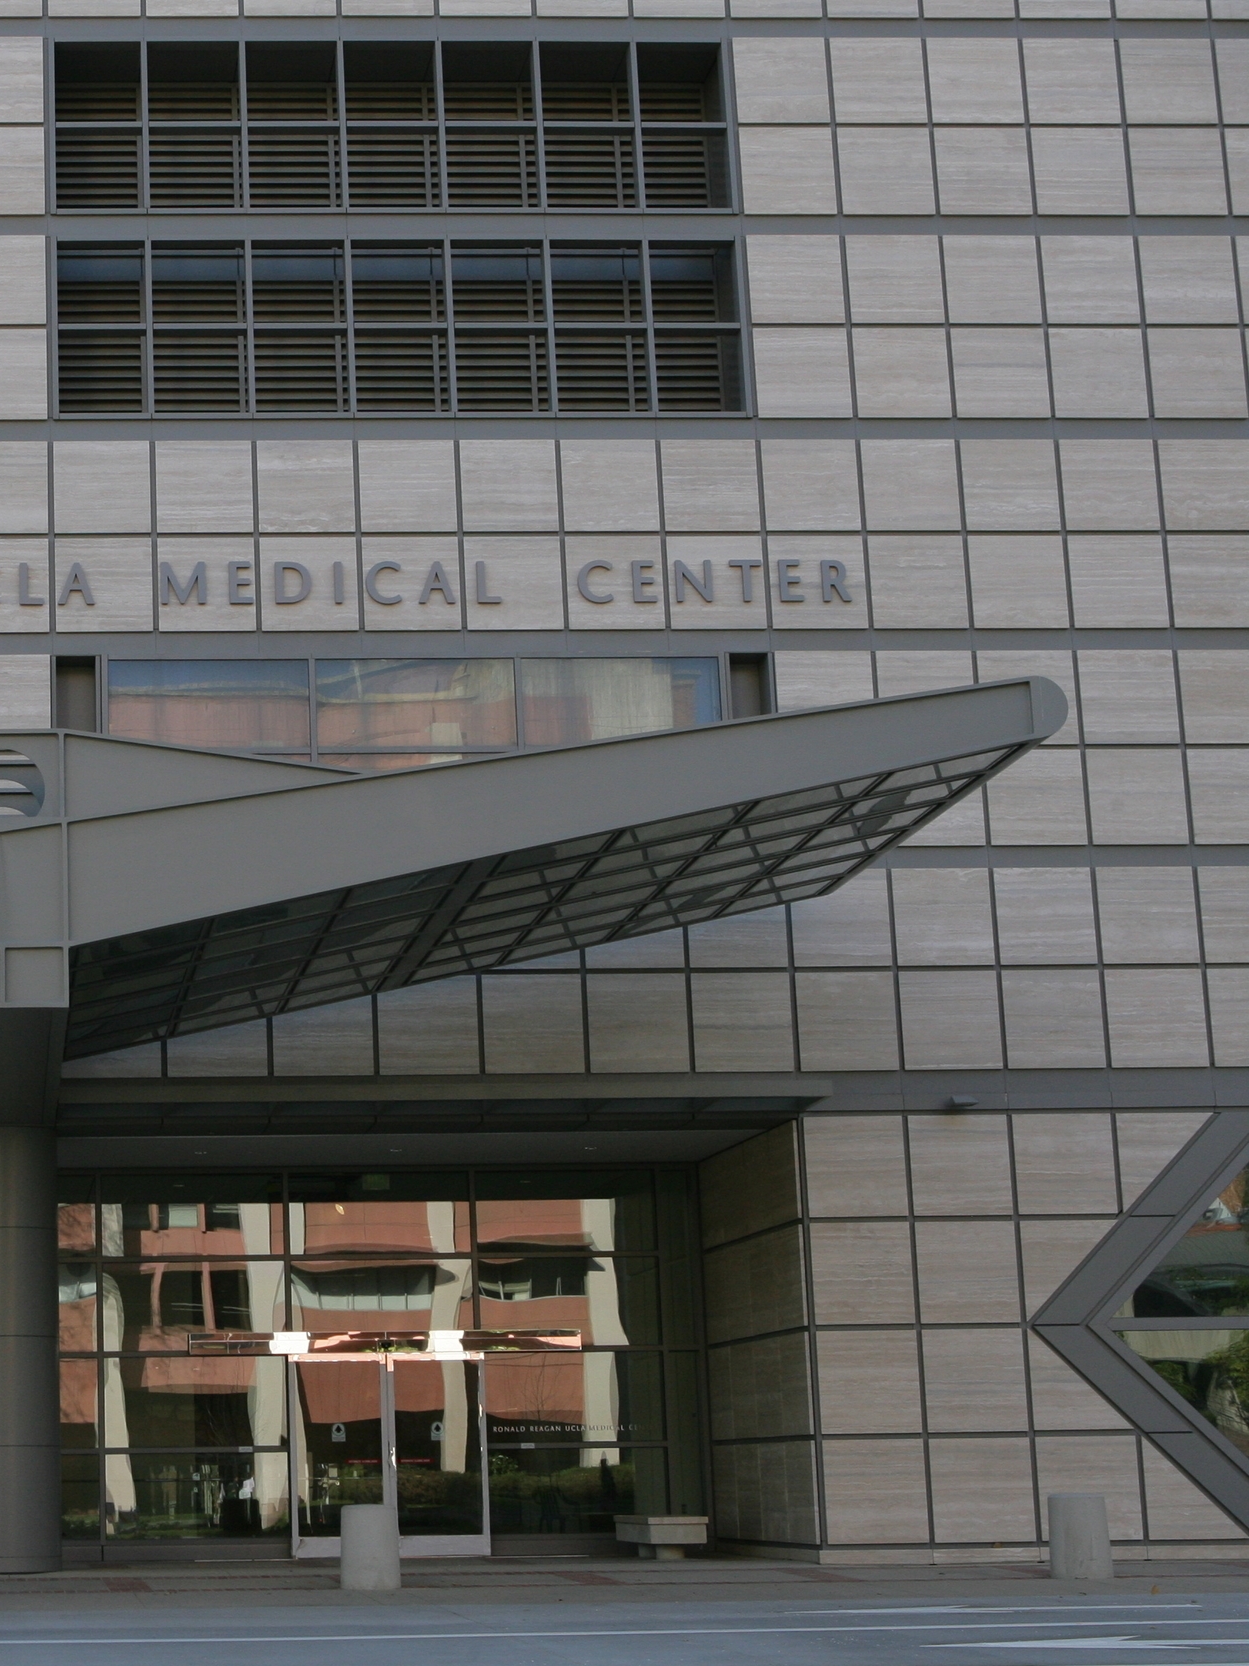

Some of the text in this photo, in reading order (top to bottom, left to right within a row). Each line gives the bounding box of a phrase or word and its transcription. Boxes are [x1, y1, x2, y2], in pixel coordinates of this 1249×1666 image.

[159, 560, 503, 606] MEDICAL
[576, 559, 853, 604] CENTER
[492, 1425, 526, 1433] RONALD
[565, 1424, 586, 1432] UCLA
